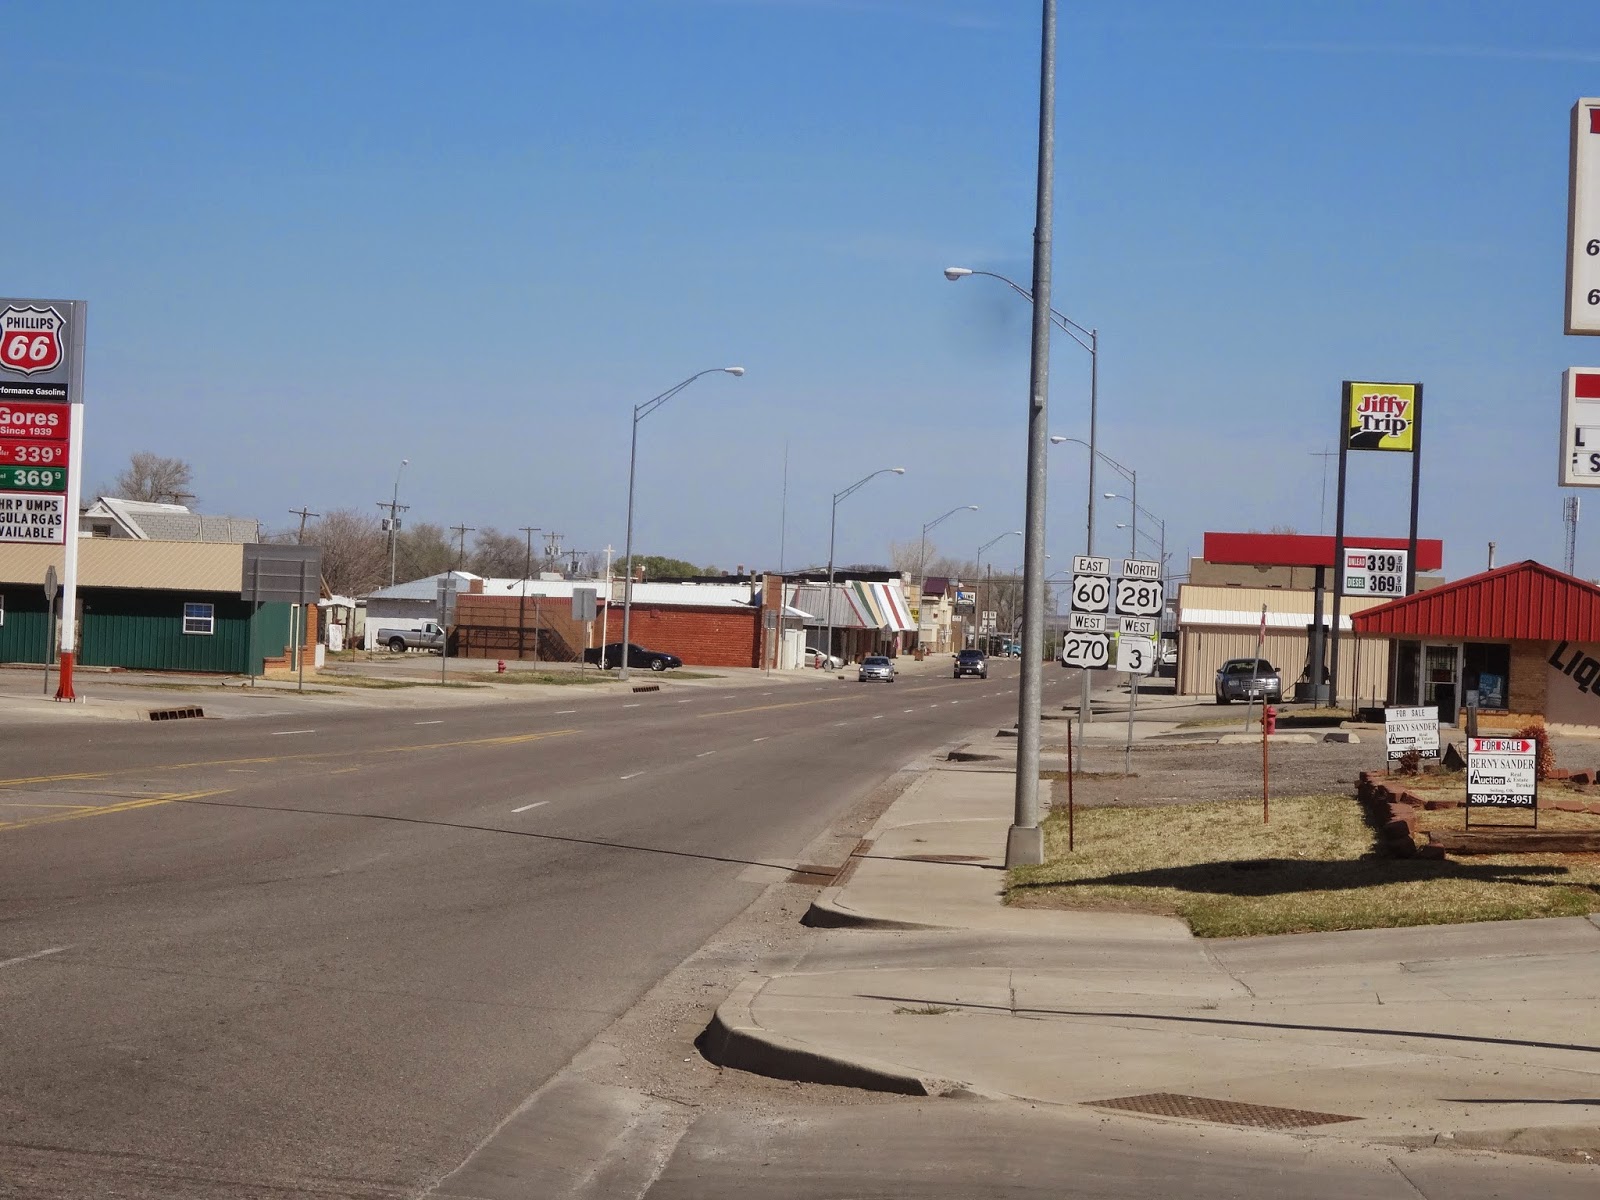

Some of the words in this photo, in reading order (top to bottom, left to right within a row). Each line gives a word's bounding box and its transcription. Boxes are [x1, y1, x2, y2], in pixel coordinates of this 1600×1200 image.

[7, 317, 54, 330] PHILLIPS
[8, 336, 50, 361] 66
[0, 386, 34, 395] formance
[36, 388, 66, 396] Gasoline
[1357, 395, 1408, 418] Jiffy
[0, 407, 59, 426] Gores
[0, 427, 26, 435] Since
[29, 428, 52, 436] 1939
[1360, 414, 1407, 435] Trip
[14, 446, 54, 463] 339
[55, 448, 61, 456] 9
[14, 470, 54, 487] 369
[55, 472, 61, 480] 9
[1080, 560, 1103, 572] EAST
[1125, 563, 1157, 576] NORTH
[1348, 557, 1366, 566] UNLEAD
[1367, 555, 1395, 571] 339
[1347, 578, 1365, 587] DIESEL
[1370, 575, 1395, 591] 369
[1077, 583, 1105, 603] 60
[1122, 587, 1158, 607] 281
[1075, 615, 1101, 628] WEST
[1125, 620, 1151, 633] WEST
[1067, 639, 1105, 660] 270
[1129, 649, 1142, 669] 3
[1396, 710, 1406, 718] FOR
[1411, 709, 1425, 717] SALE
[1388, 723, 1409, 733] BERNY
[1411, 723, 1437, 732] SANDER
[1389, 733, 1415, 744] Auction
[1481, 741, 1496, 751] FOR
[1501, 741, 1521, 751] SALE
[1470, 759, 1498, 769] BERNY
[1500, 759, 1534, 770] SANDER
[1471, 769, 1504, 785] Auction
[1471, 794, 1532, 804] 580-922-4951
